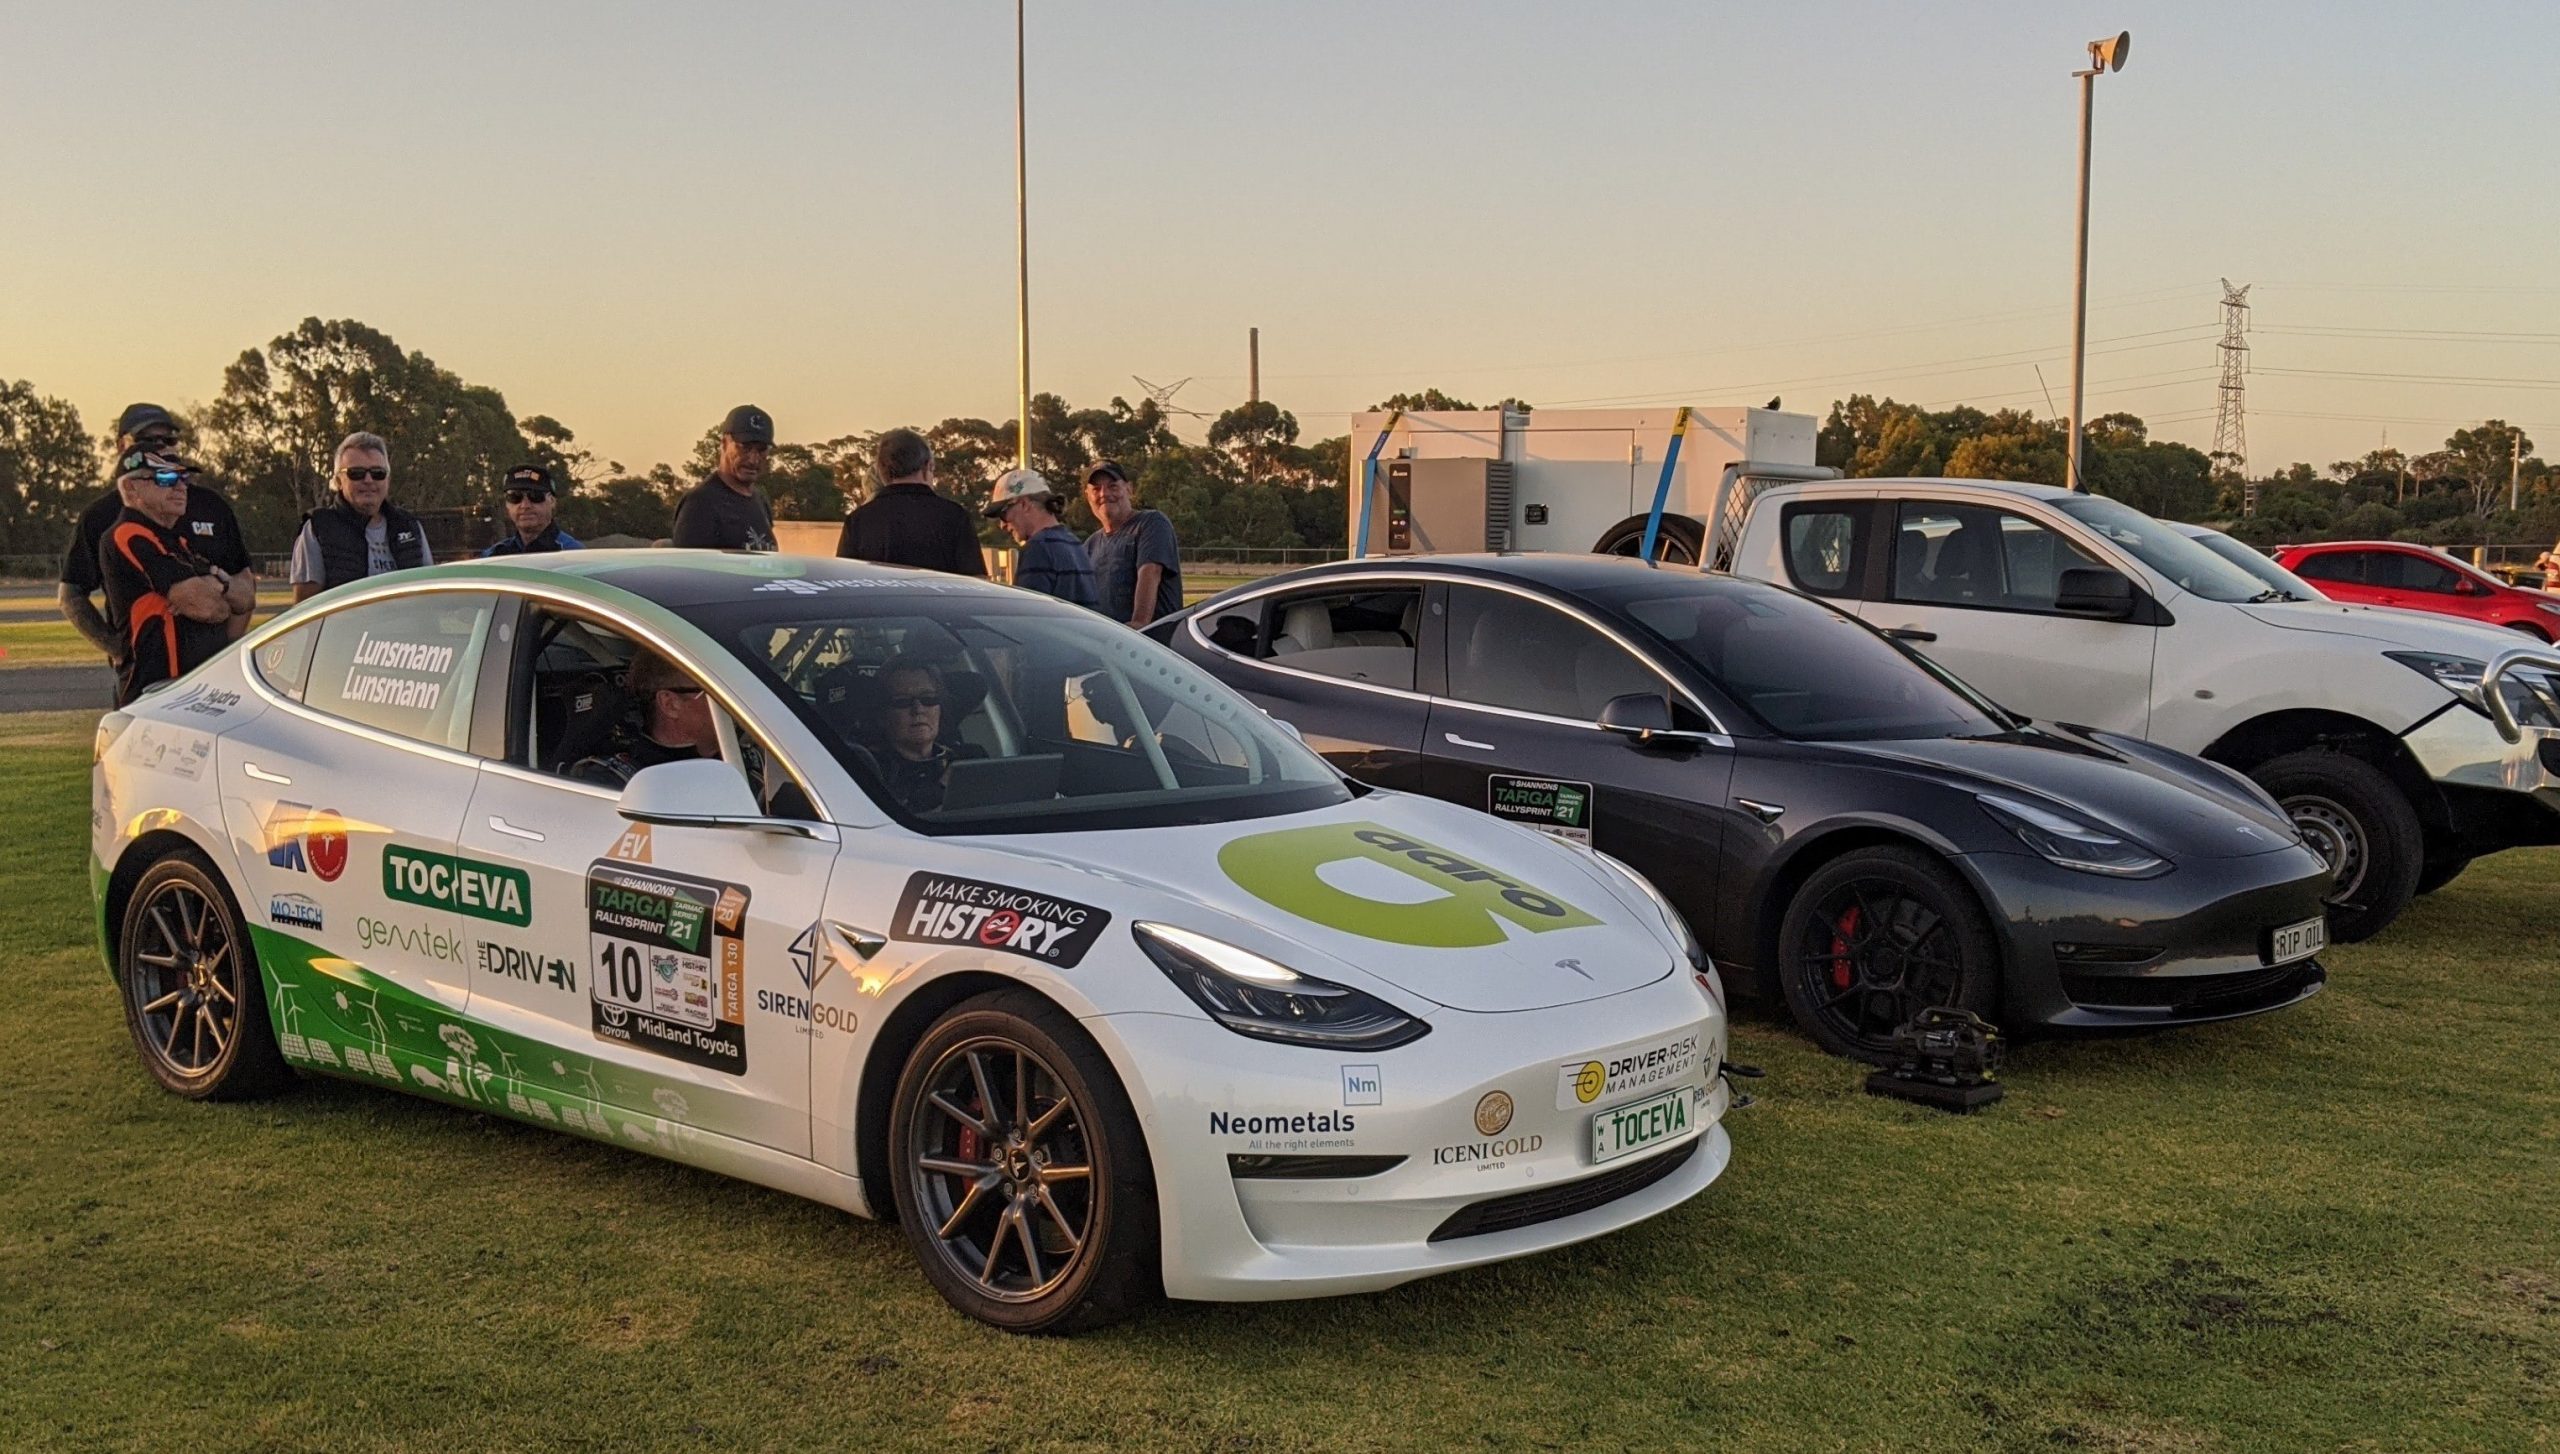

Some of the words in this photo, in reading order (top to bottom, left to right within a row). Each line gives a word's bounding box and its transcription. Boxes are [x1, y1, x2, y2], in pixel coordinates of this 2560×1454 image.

[192, 521, 214, 536] CAT
[353, 631, 453, 673] Lunsmann
[203, 688, 241, 706] Hydro
[341, 666, 440, 709] Lunsmann
[1496, 787, 1554, 806] TARGA
[1516, 780, 1558, 791] SHANNONS
[1494, 803, 1552, 816] RALLYSPRINT
[618, 833, 648, 858] EV
[621, 877, 676, 897] SHANNONS
[271, 900, 322, 921] MO-TECH
[596, 886, 667, 919] TARGA
[674, 901, 705, 914] TARMAC
[922, 880, 984, 903] MAKE
[982, 889, 1088, 925] SMOKING
[595, 909, 665, 935] RALLYSPRINT
[672, 910, 698, 921] SERIES
[477, 939, 487, 970] THE
[728, 942, 738, 966] 130
[2280, 931, 2299, 956] RIP
[601, 941, 642, 1003] 10
[728, 972, 738, 1018] TARGA
[600, 1024, 631, 1040] TOYOTA
[637, 1016, 691, 1045] Midland
[693, 1032, 738, 1058] Toyota
[1348, 1077, 1377, 1093] Nm
[1605, 1054, 1697, 1095] MANAGEMENT
[1210, 1109, 1355, 1135] Neometals
[1611, 1097, 1686, 1150] TOCEVA
[1249, 1140, 1262, 1149] All
[1265, 1139, 1281, 1149] the
[1284, 1138, 1307, 1151] right
[1309, 1138, 1355, 1149] elements
[1477, 1161, 1506, 1172] LIMITED
